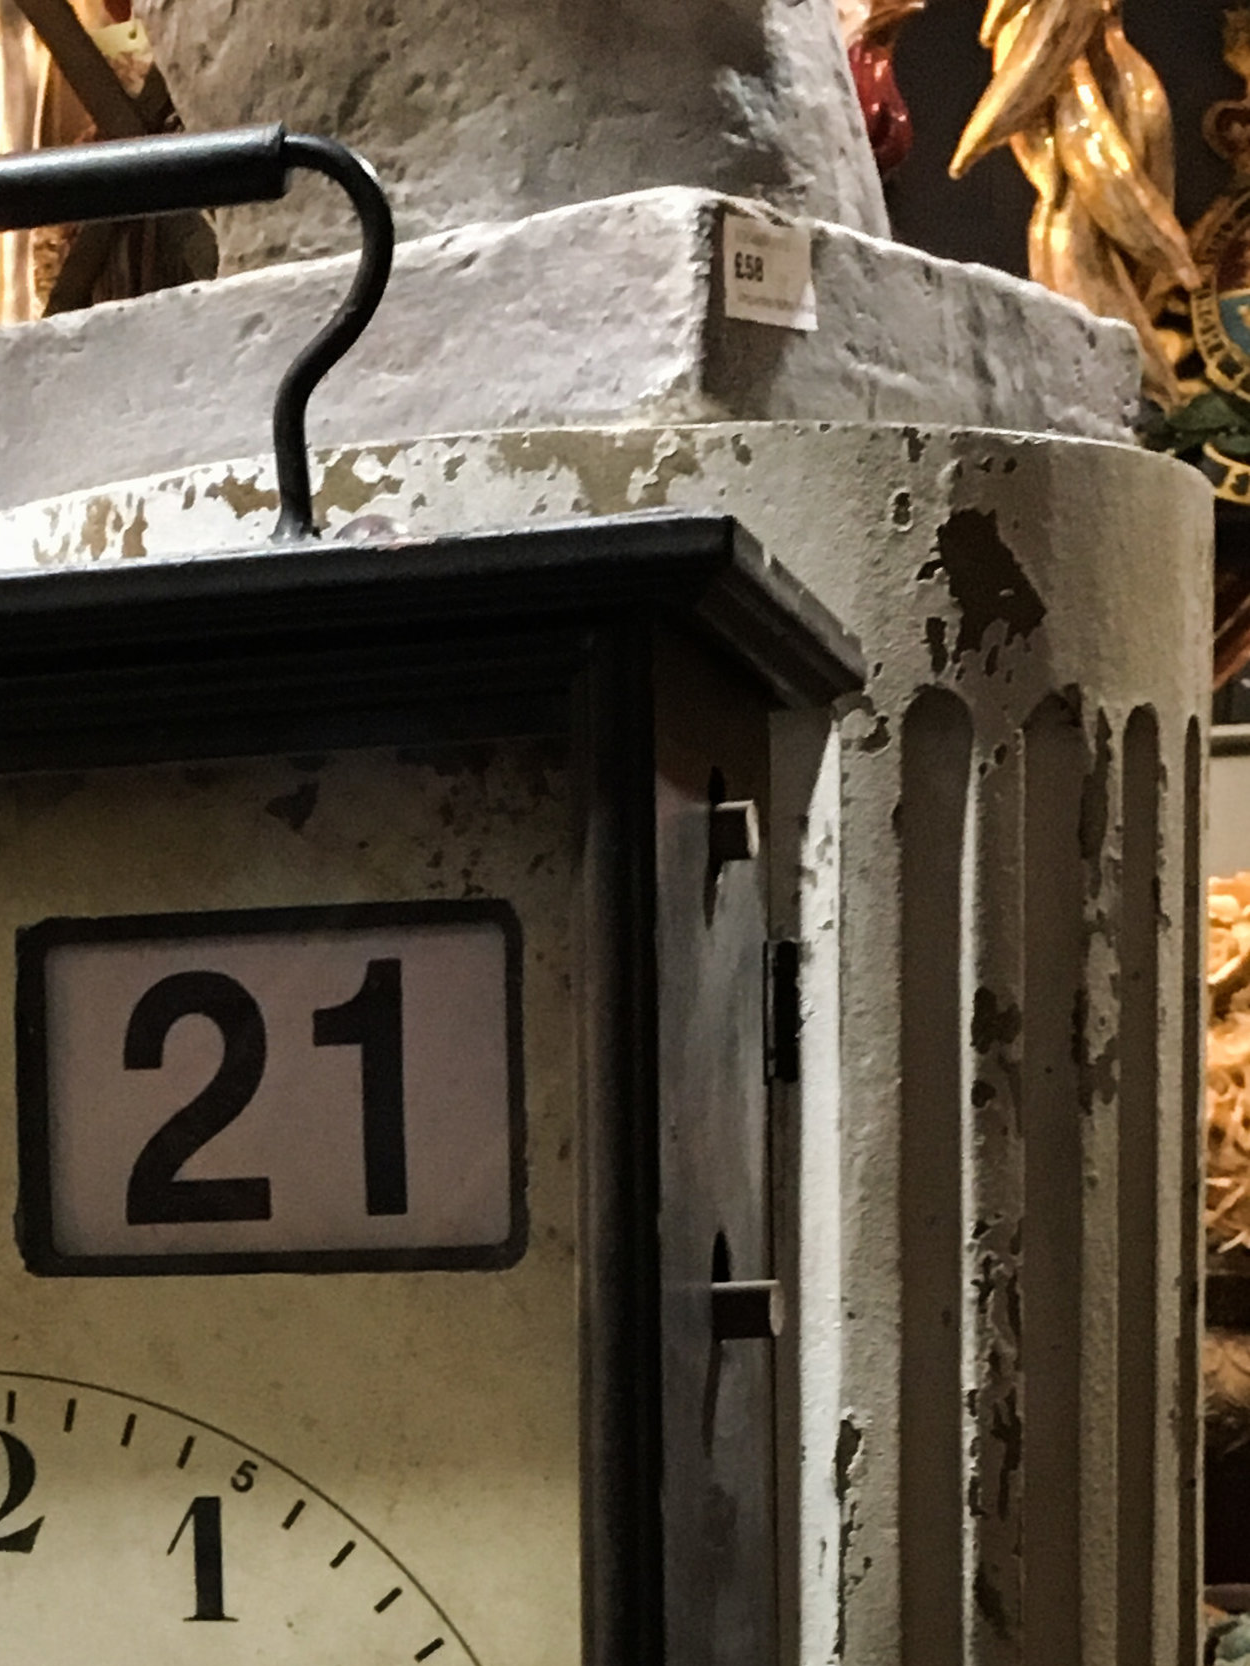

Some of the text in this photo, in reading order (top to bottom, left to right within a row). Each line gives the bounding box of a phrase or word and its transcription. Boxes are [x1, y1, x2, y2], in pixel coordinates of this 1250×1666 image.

[123, 958, 409, 1226] 21
[230, 1459, 259, 1493] 5
[166, 1495, 240, 1623] 1
